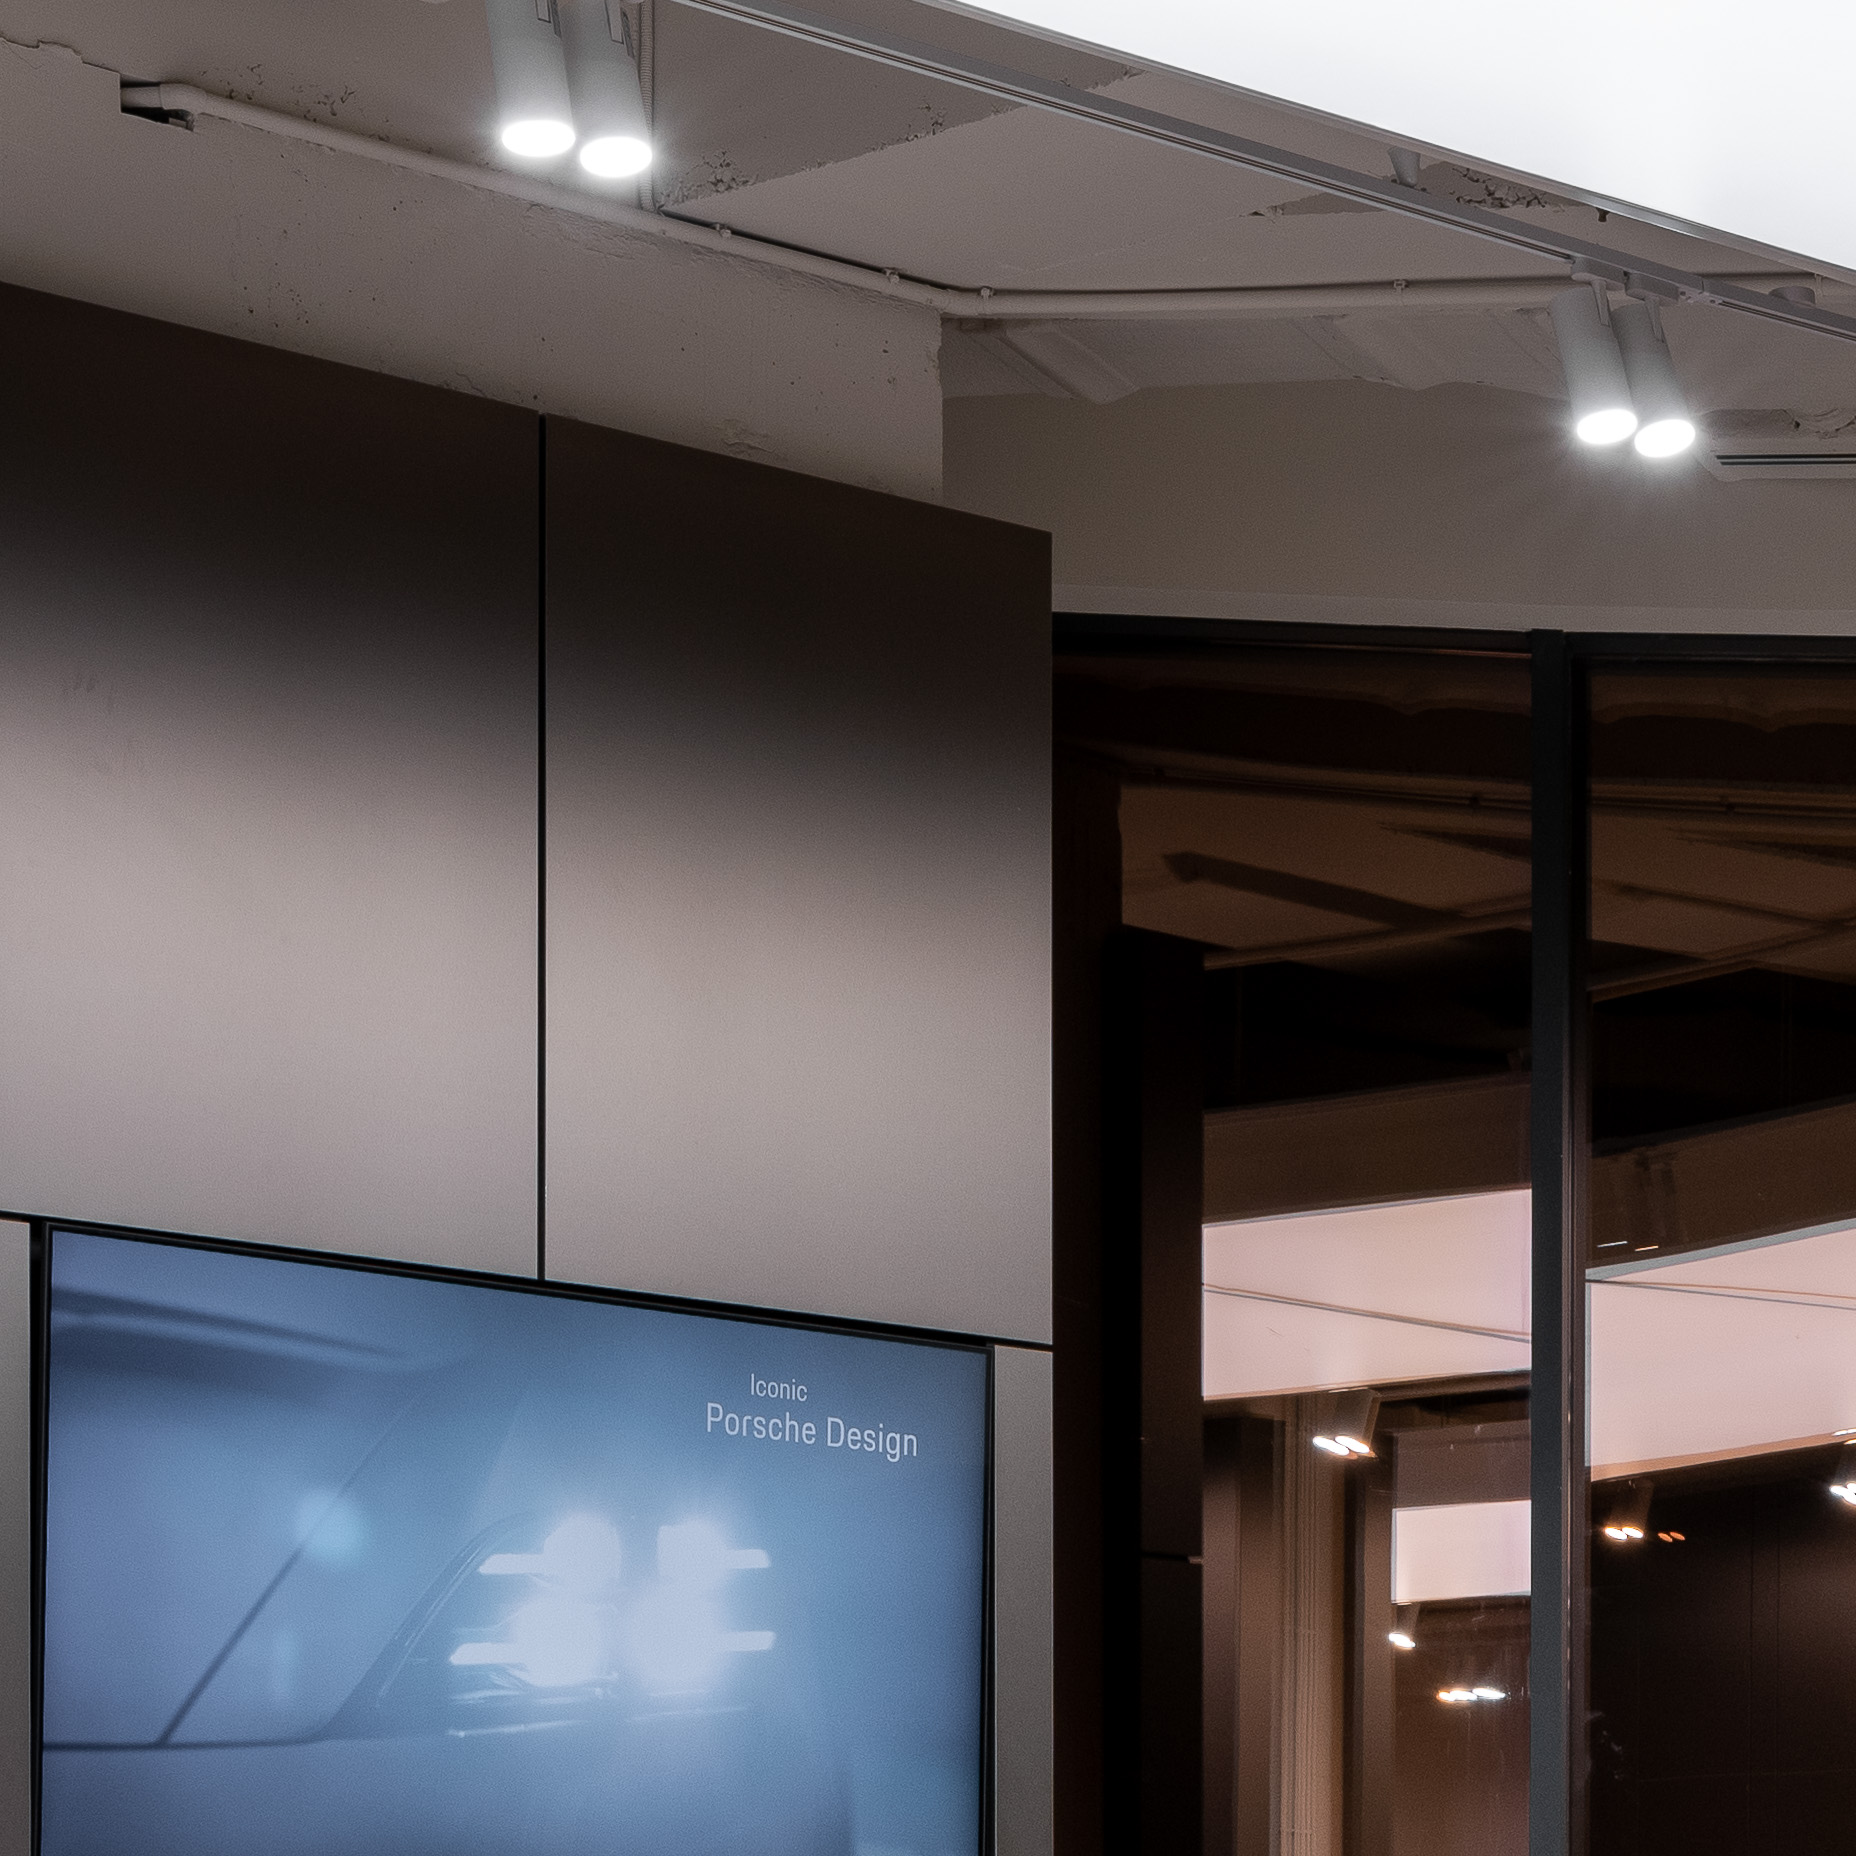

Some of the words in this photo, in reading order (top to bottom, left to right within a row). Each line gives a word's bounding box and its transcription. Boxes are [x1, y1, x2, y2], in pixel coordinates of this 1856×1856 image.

[751, 1373, 808, 1401] Iconic
[707, 1402, 816, 1445] Porsche
[827, 1416, 918, 1463] Design
